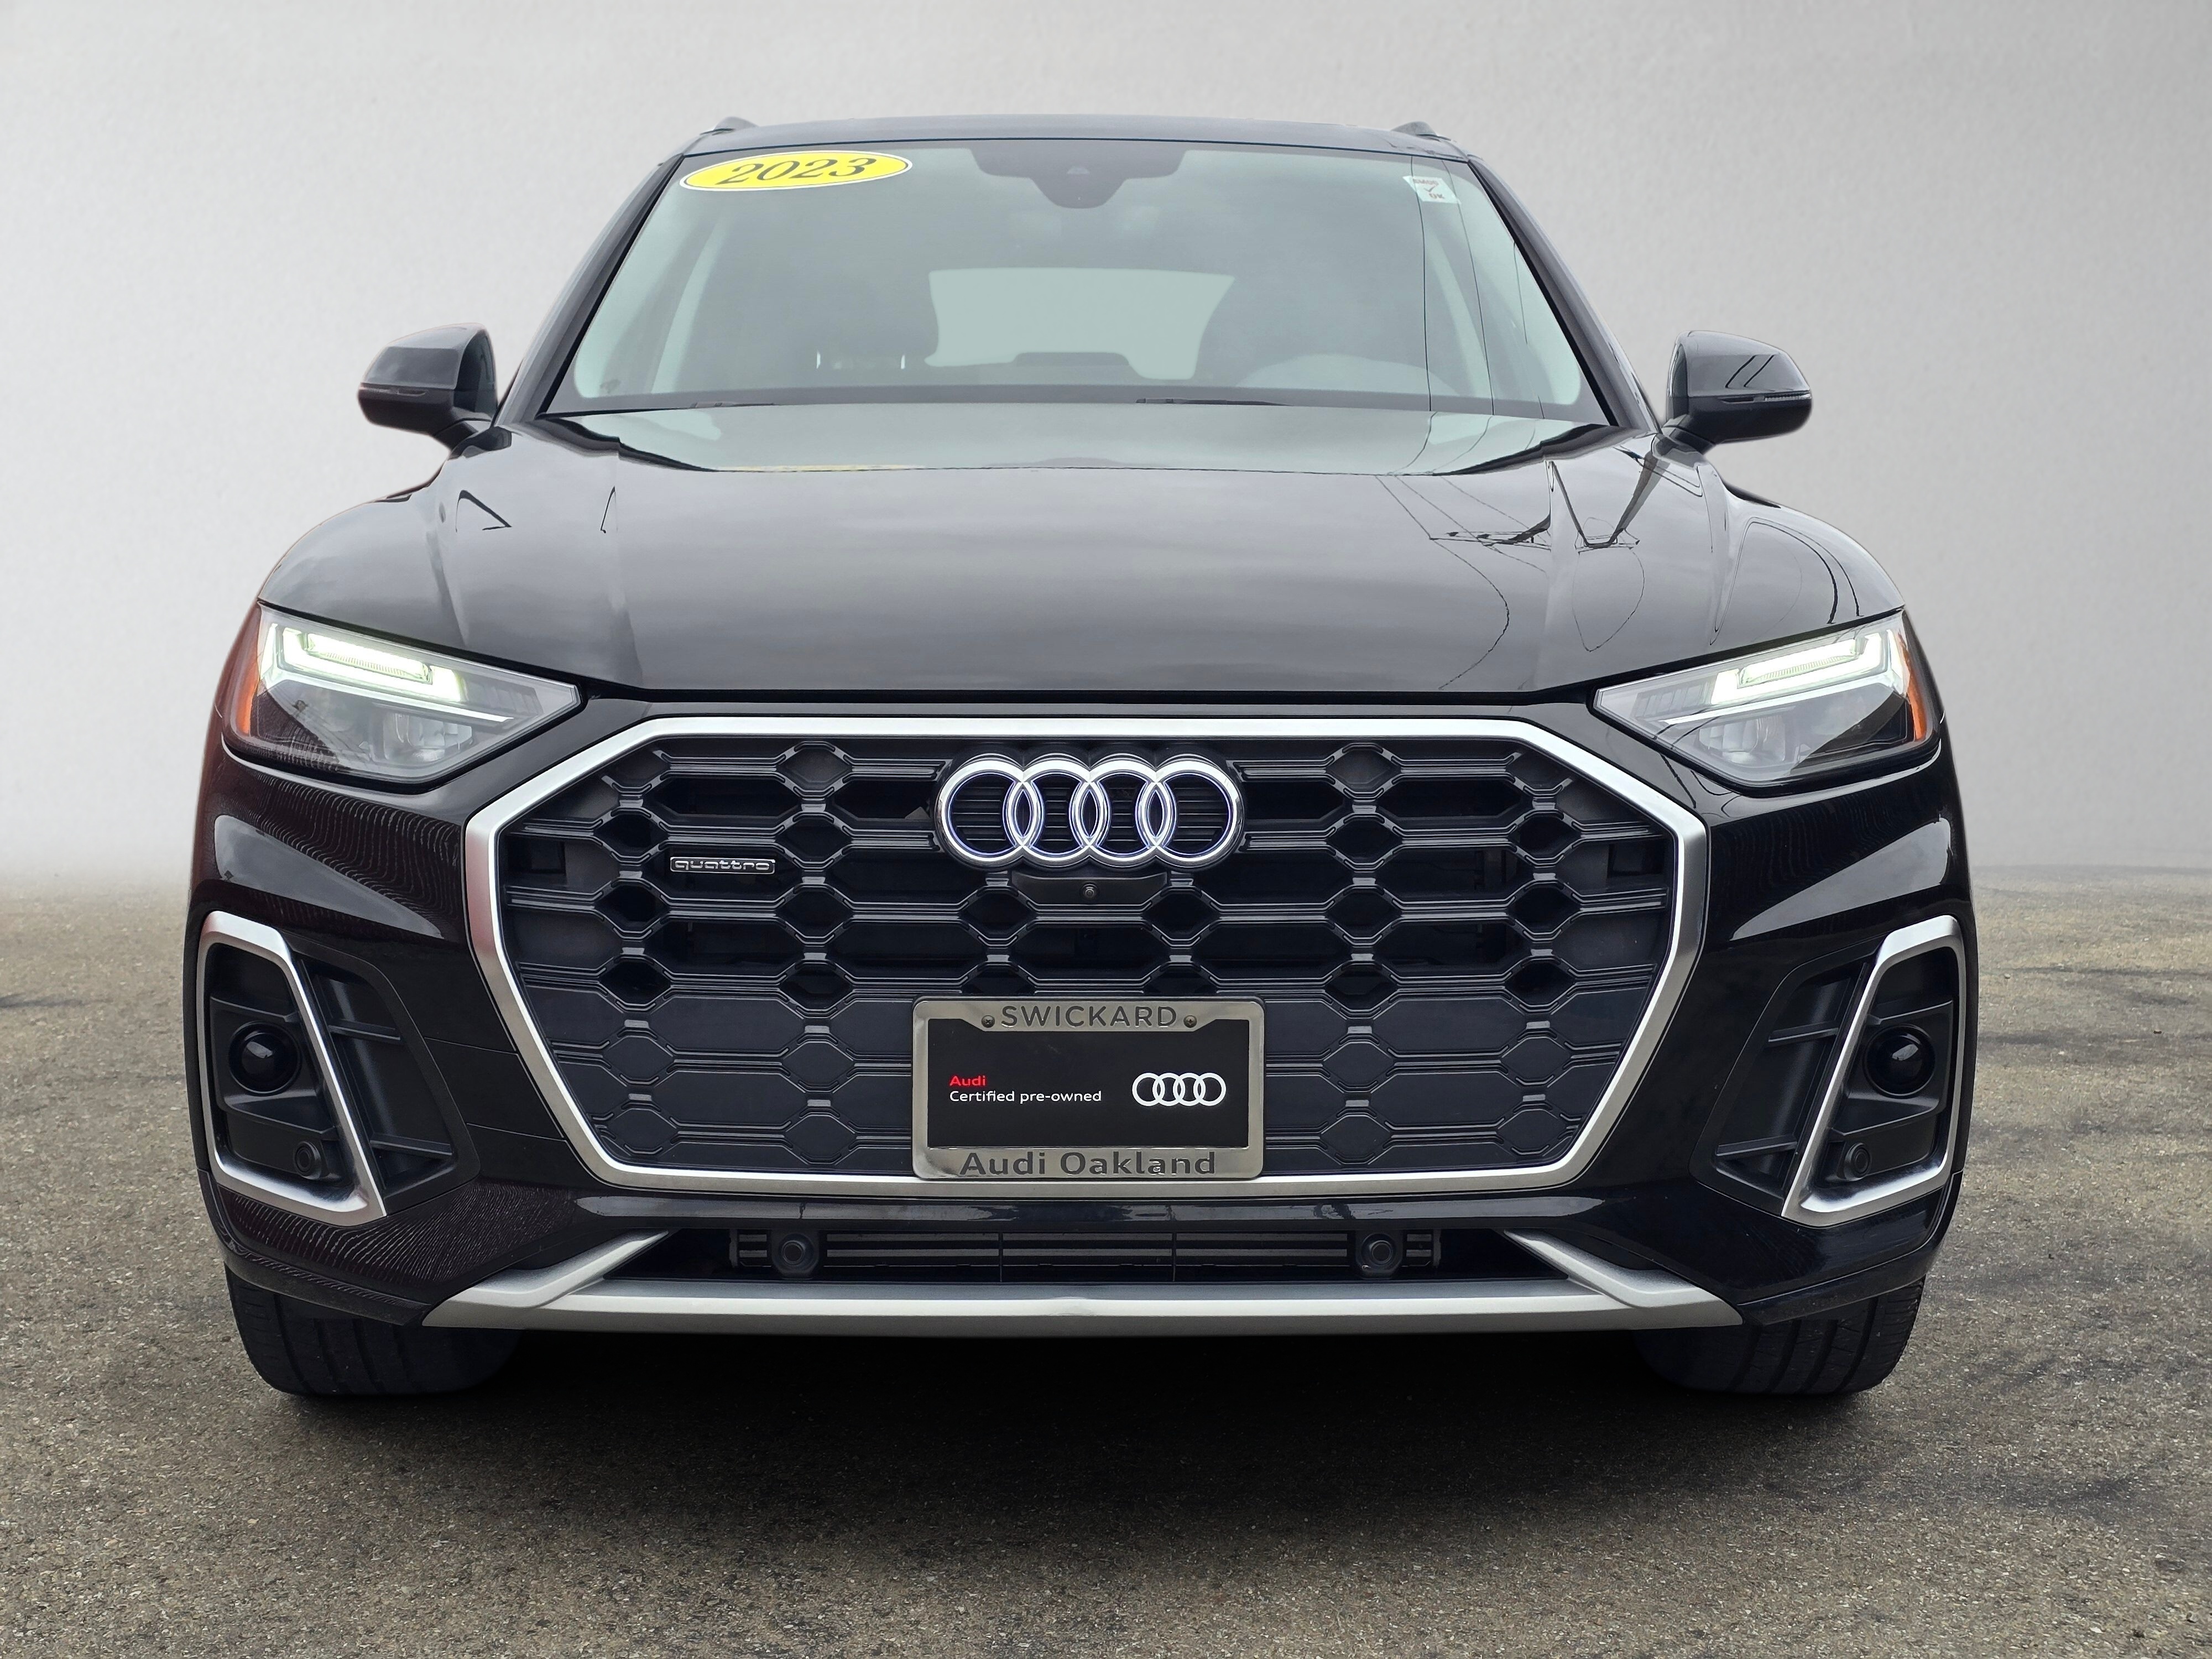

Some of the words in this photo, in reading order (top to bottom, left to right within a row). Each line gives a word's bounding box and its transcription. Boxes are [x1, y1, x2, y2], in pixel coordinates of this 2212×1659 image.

[716, 158, 877, 185] 2023
[675, 860, 770, 870] quattro
[1001, 1005, 1177, 1027] SWICKARD
[950, 1076, 986, 1086] Audi
[950, 1090, 1015, 1102] Certified
[1020, 1090, 1102, 1104] pre-owned
[959, 1152, 1046, 1175] Audi
[1060, 1151, 1215, 1175] Oakland
